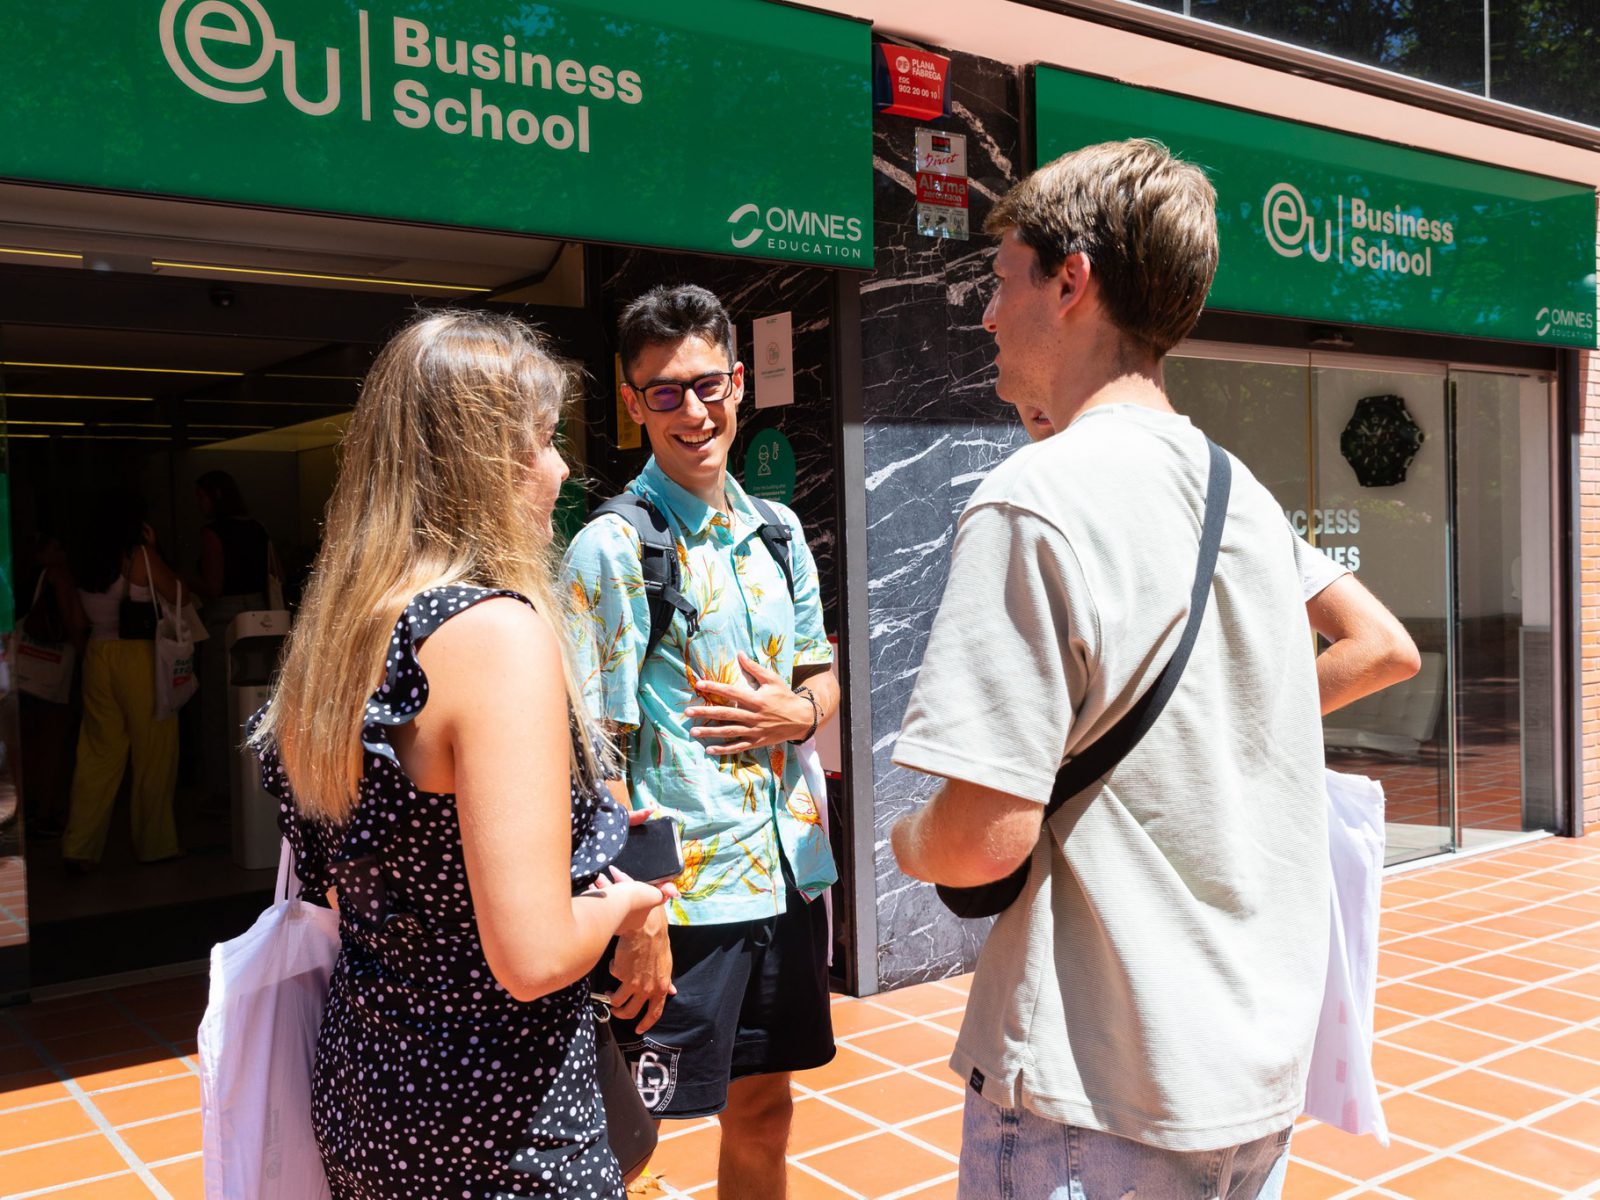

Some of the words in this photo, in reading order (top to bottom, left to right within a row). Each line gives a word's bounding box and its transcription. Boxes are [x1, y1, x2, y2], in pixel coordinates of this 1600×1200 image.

[393, 16, 643, 105] Business
[912, 58, 935, 71] PLANA
[912, 67, 942, 81] FABREGA
[898, 84, 911, 94] 902
[912, 87, 921, 96] 20
[921, 88, 930, 98] 00
[930, 91, 938, 100] 10
[393, 79, 591, 154] School
[765, 206, 862, 242] OMNES
[1351, 198, 1454, 245] Business
[767, 238, 861, 259] EDUCATION
[1350, 236, 1432, 277] School
[1551, 308, 1593, 329] OMNES
[1285, 508, 1360, 536] CCESS
